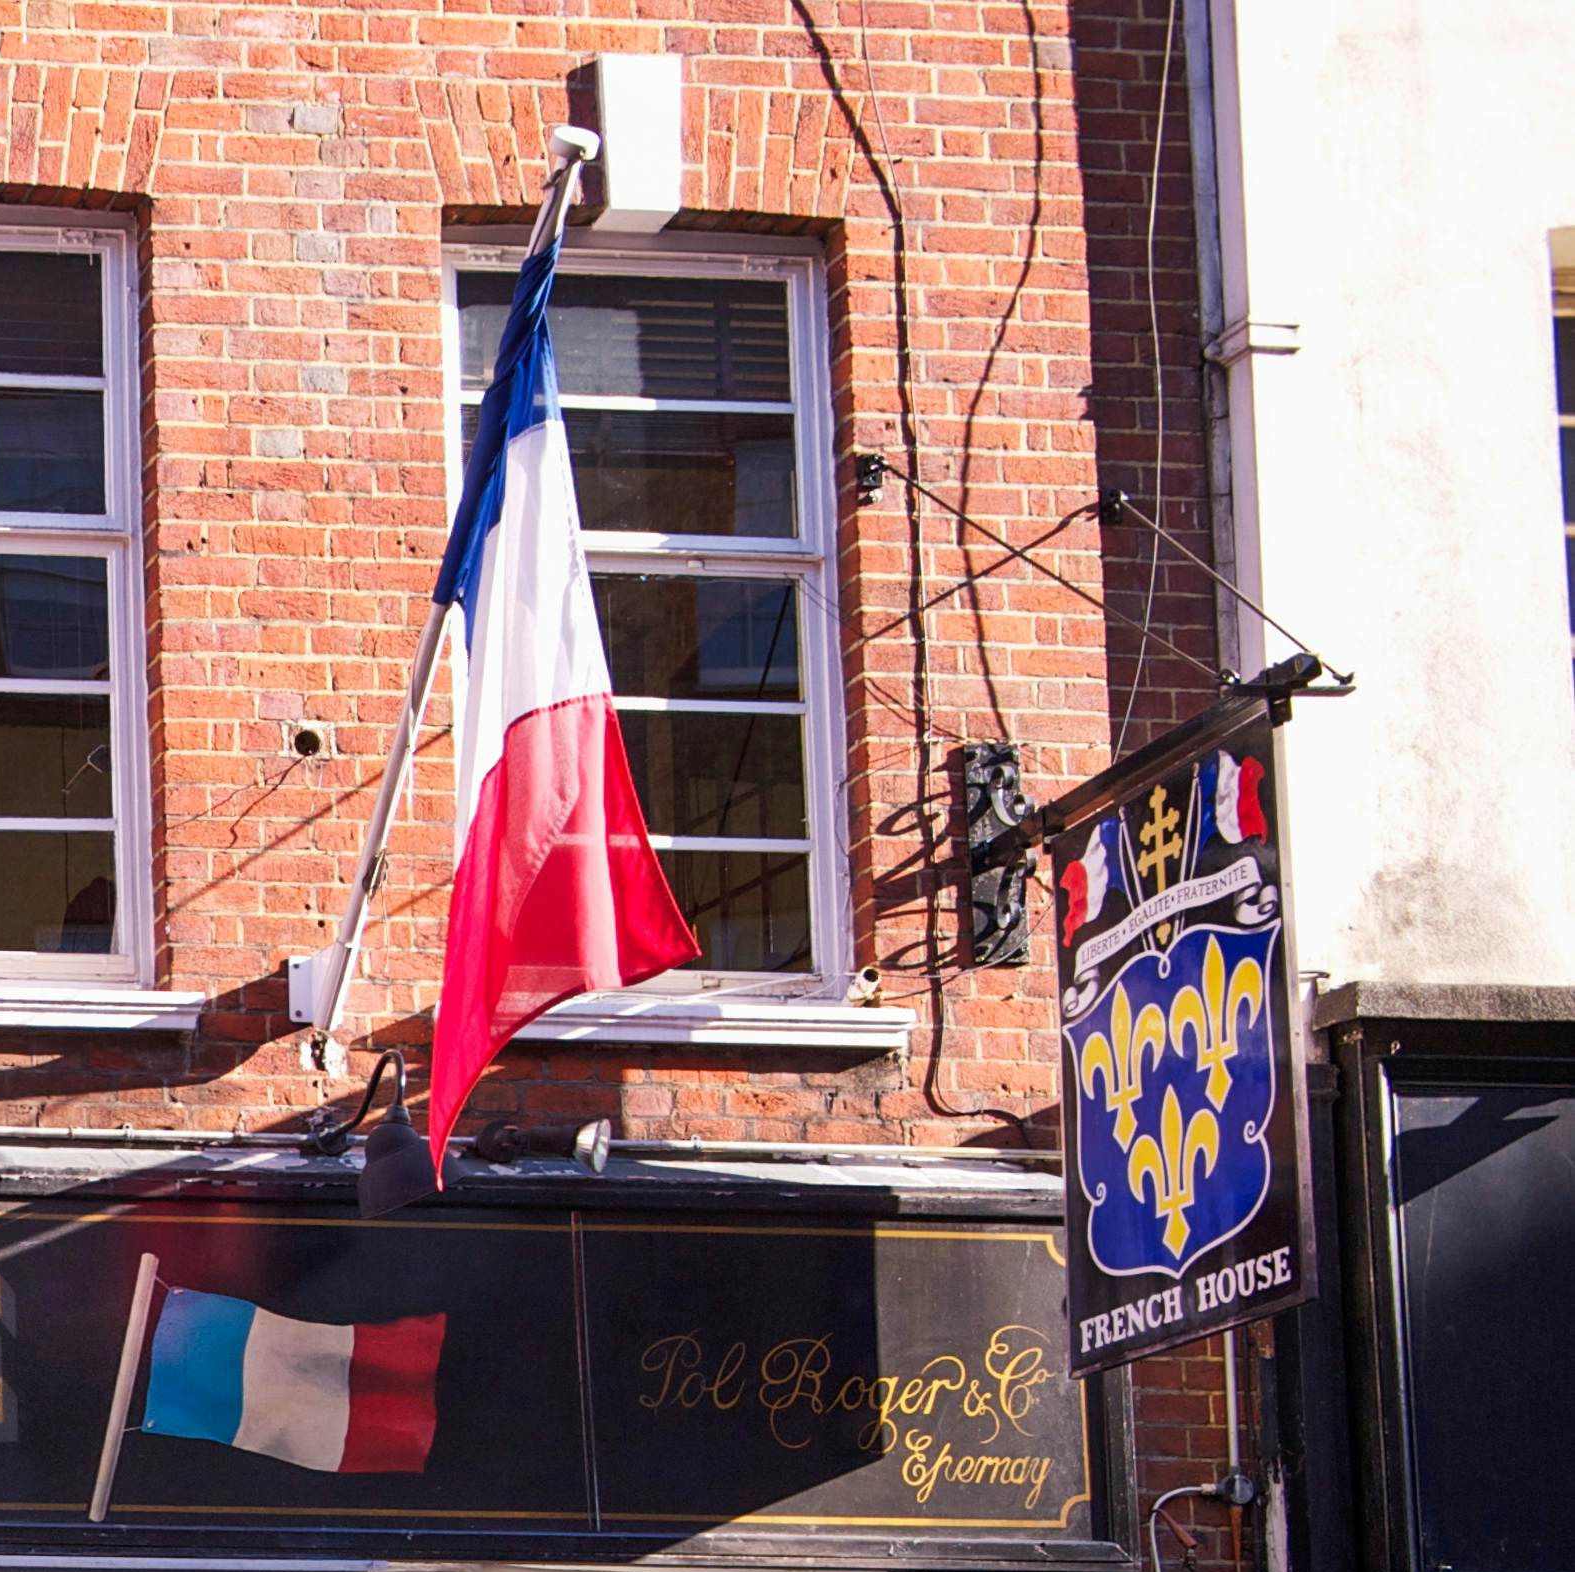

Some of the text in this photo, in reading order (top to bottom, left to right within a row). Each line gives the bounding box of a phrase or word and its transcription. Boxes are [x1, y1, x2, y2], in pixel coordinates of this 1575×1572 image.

[1081, 864, 1248, 965] LIBERTE EGALITE FRATERNITE
[1079, 1246, 1292, 1354] FRENCH HOUSE
[640, 1327, 747, 1410] Pol
[758, 1331, 965, 1453] Roger
[903, 1429, 1054, 1509] Epernay
